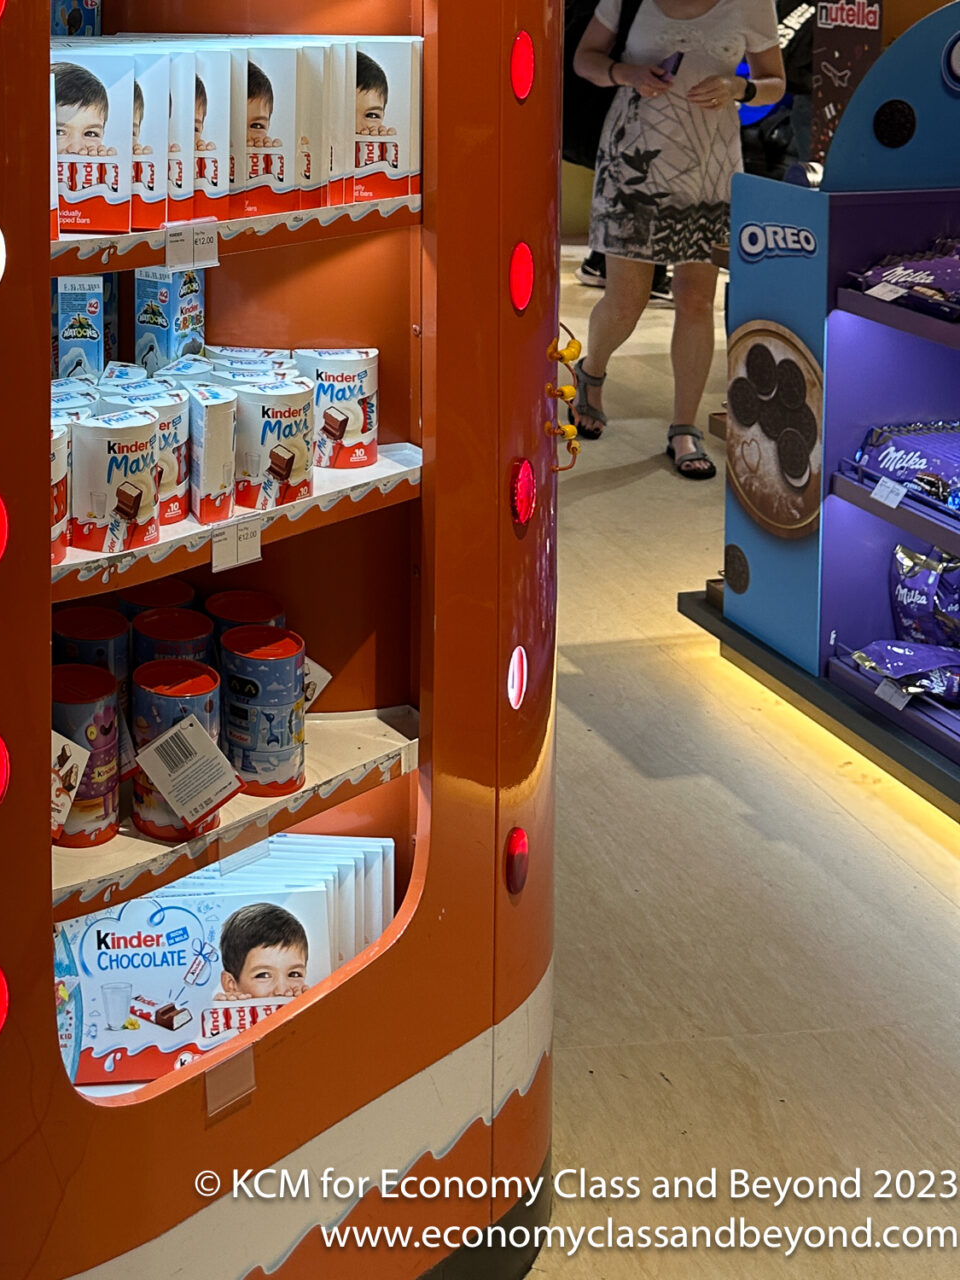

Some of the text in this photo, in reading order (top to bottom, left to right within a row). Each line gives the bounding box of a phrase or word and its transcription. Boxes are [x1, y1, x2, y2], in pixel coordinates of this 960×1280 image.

[818, 0, 879, 29] nutella
[741, 223, 817, 257] OREO
[881, 266, 936, 284] Milka
[315, 379, 365, 406] Maxi
[261, 413, 309, 445] Maxi
[106, 446, 156, 484] Maxi
[879, 446, 928, 470] Milka
[895, 584, 928, 605] Milka
[97, 950, 187, 970] CHOCOLATE
